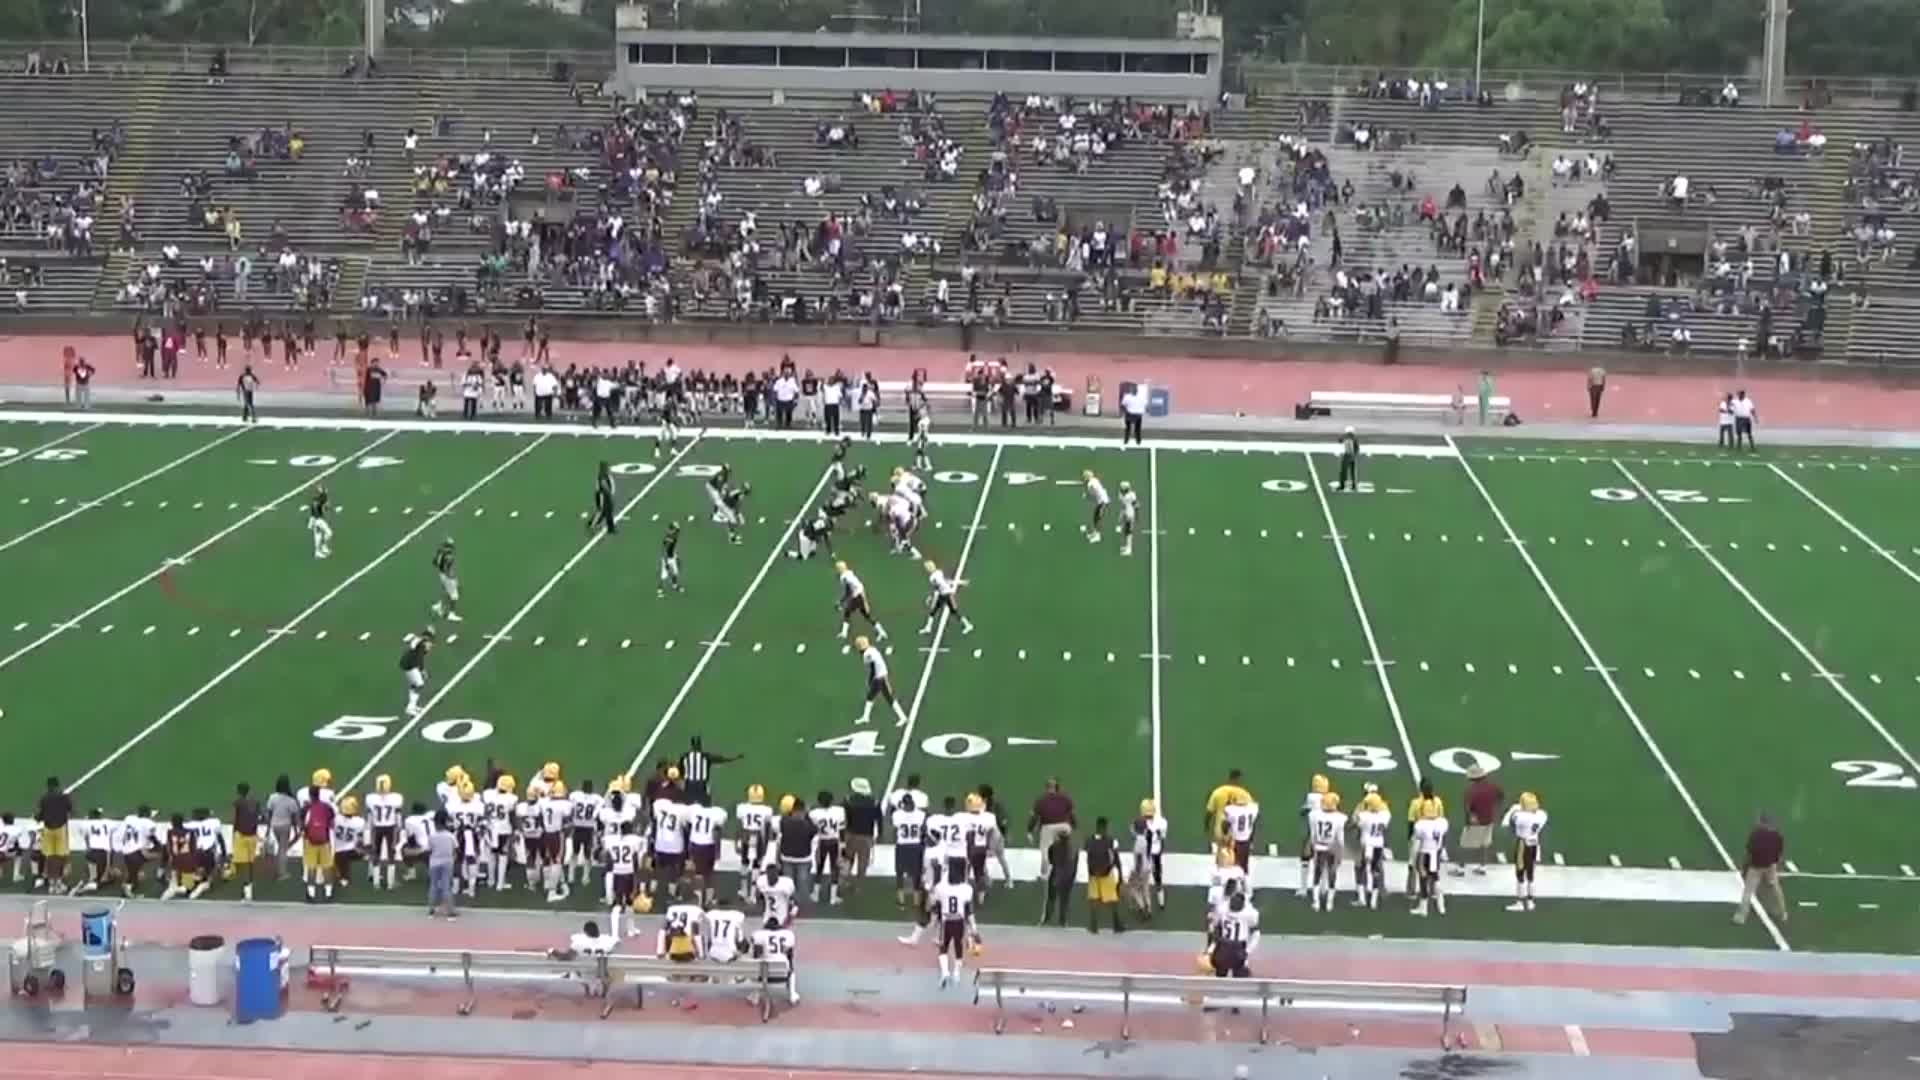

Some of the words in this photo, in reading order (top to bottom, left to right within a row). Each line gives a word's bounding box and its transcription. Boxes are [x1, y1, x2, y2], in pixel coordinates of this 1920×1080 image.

[696, 815, 710, 833] 71
[746, 813, 762, 827] 15
[819, 818, 838, 834] 24
[940, 824, 961, 841] 72
[1317, 821, 1333, 838] 12
[714, 919, 731, 938] 17
